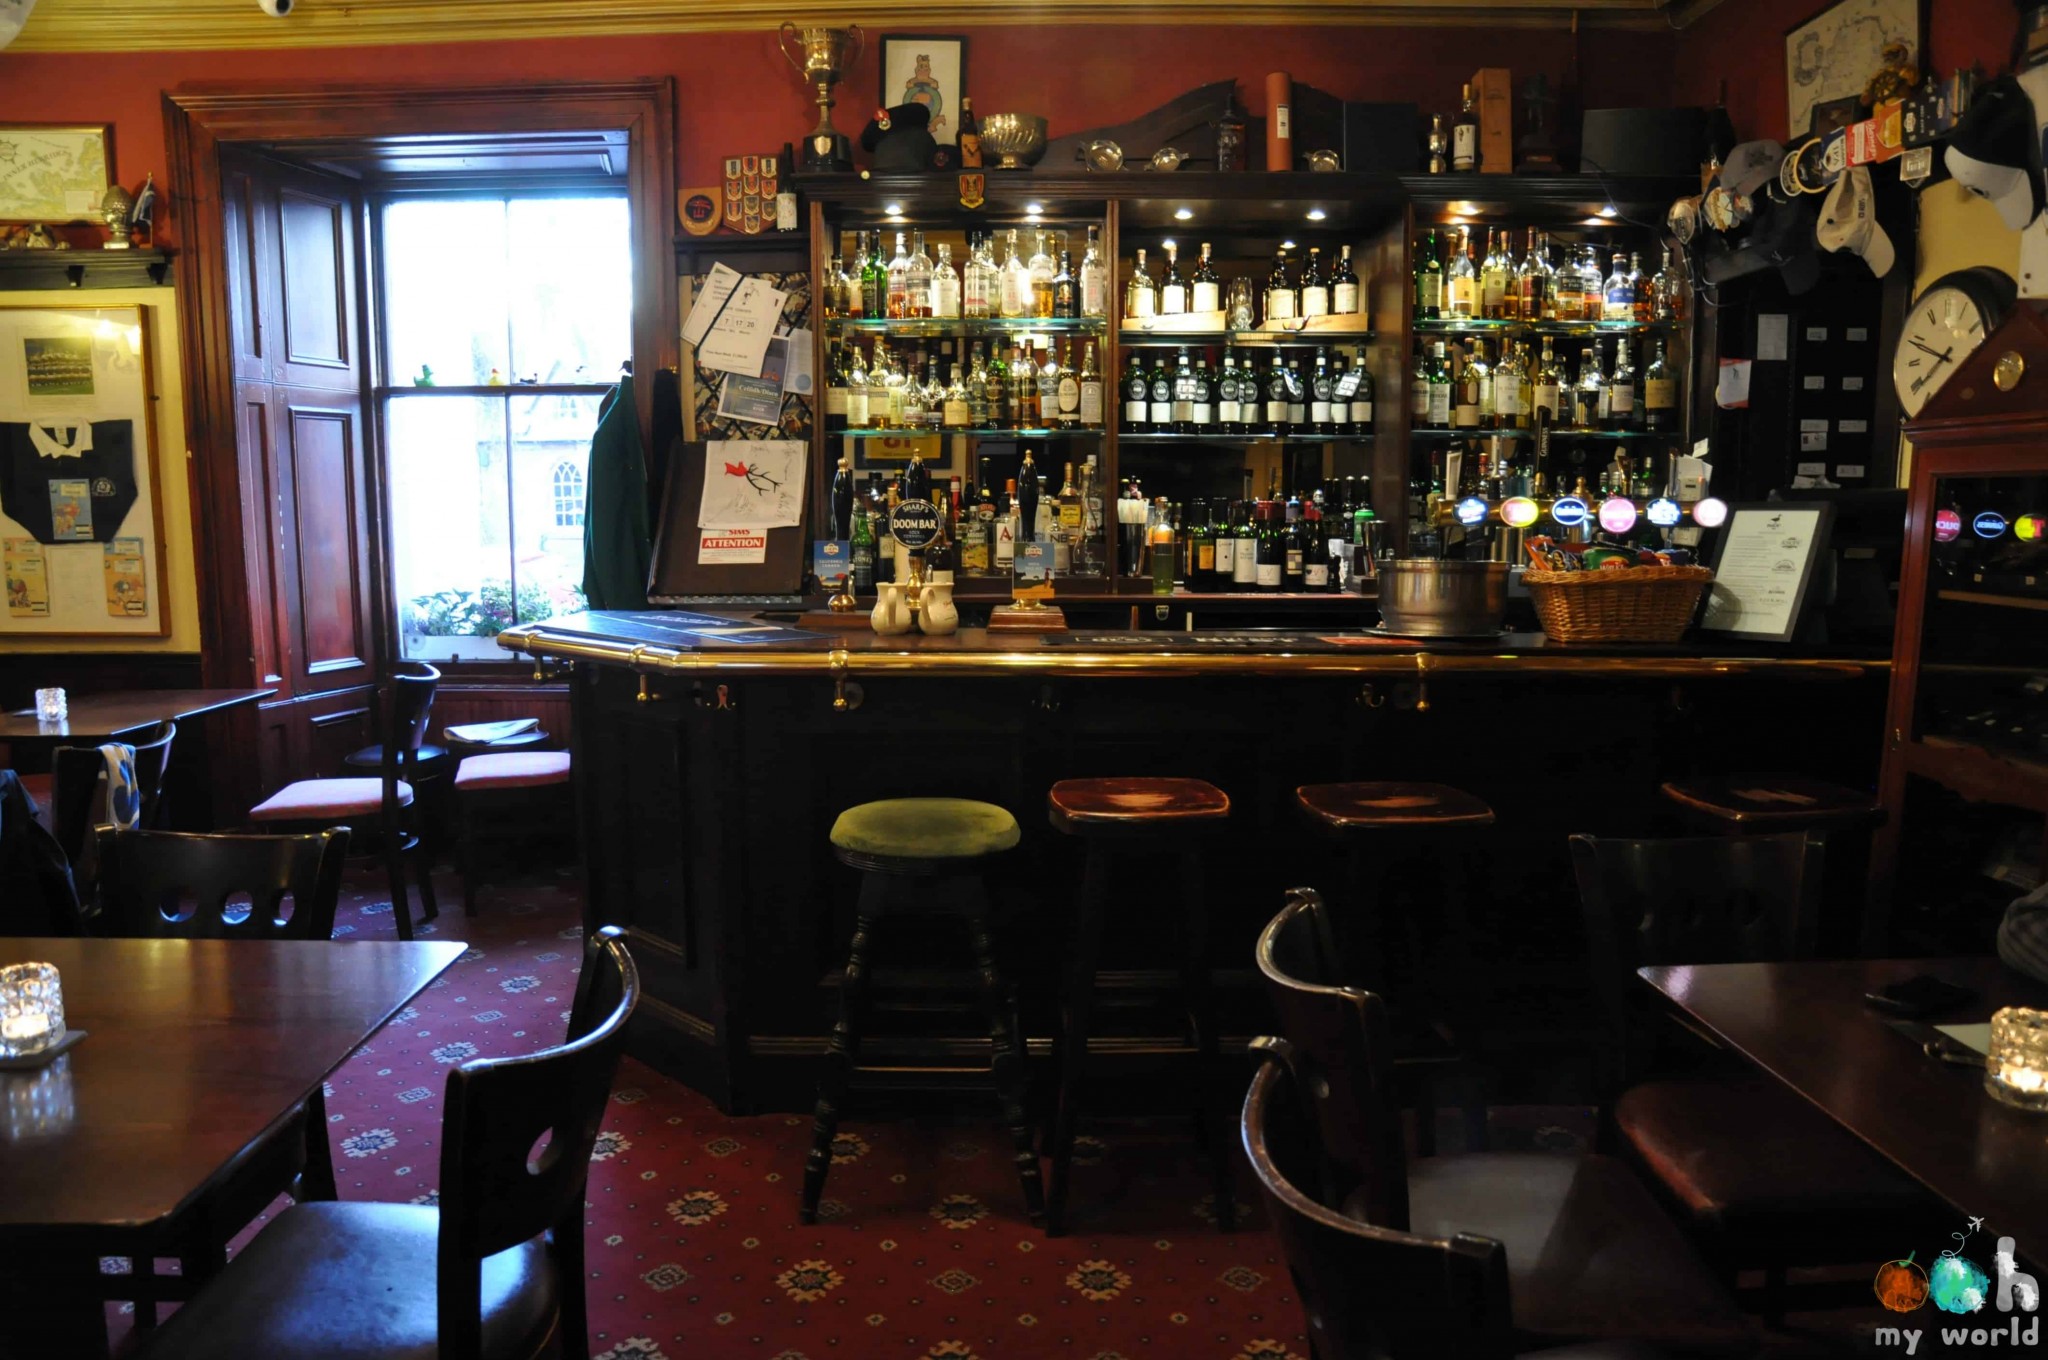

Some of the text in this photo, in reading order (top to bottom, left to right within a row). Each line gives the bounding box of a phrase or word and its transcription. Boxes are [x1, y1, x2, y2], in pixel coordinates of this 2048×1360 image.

[893, 518, 937, 529] DOOM BAR
[1000, 526, 1013, 541] A
[1050, 534, 1068, 543] NB
[705, 539, 761, 547] ATTENTION
